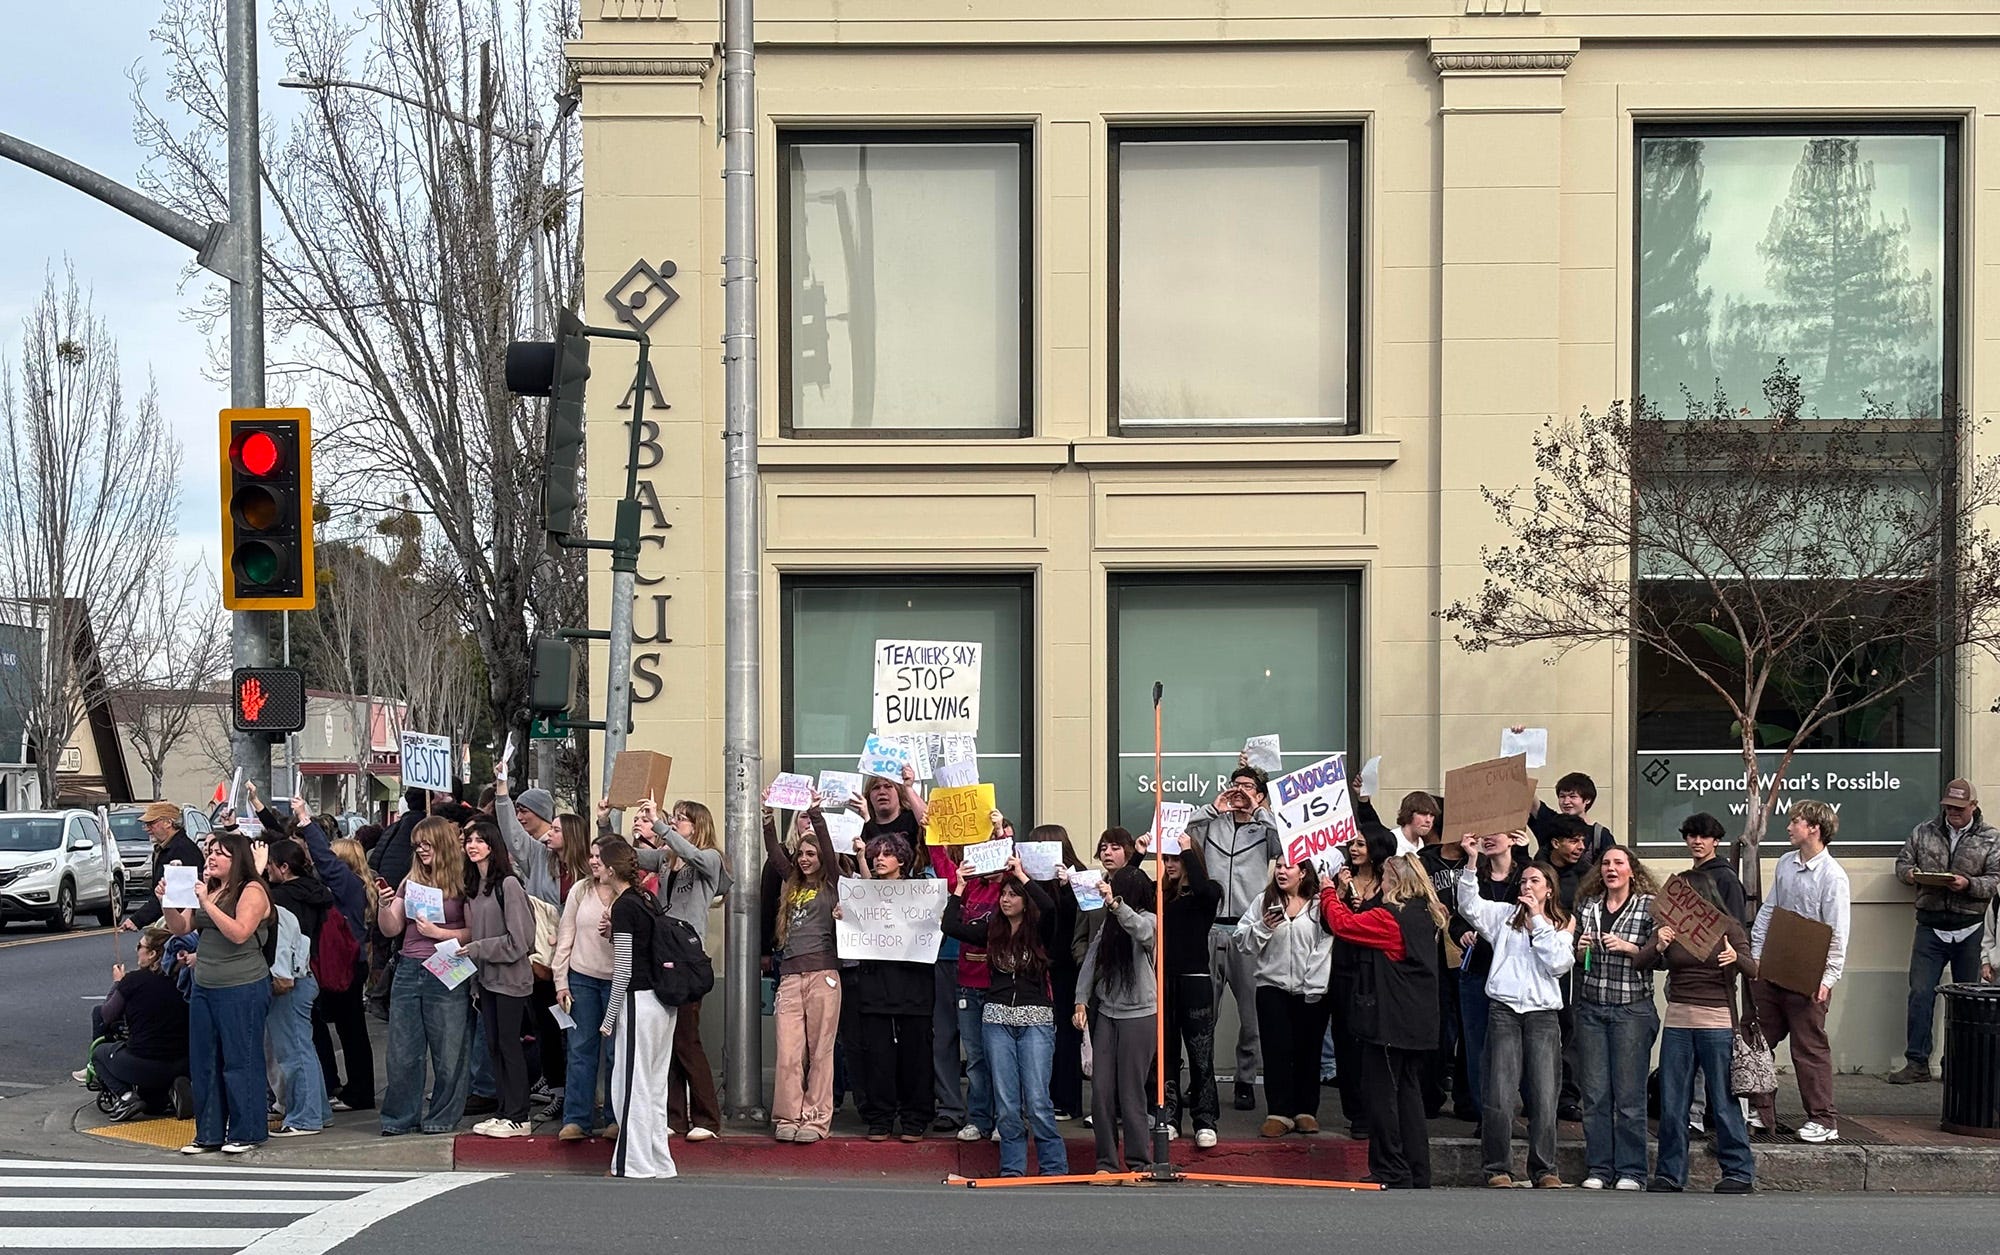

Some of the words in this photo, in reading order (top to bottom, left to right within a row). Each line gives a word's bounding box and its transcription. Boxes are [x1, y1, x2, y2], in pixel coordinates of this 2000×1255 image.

[883, 644, 950, 666] TEACHERS
[952, 645, 977, 667] SAY:
[897, 666, 955, 691] STOP
[886, 695, 970, 724] BULLYING
[404, 743, 450, 788] RESIST
[1137, 773, 1211, 797] Socially
[1276, 756, 1346, 806] ENOUGH
[1676, 771, 1748, 796] Expand
[1756, 772, 1820, 790] What's
[1826, 770, 1901, 790] Possible
[927, 788, 978, 816] MELT
[937, 812, 979, 843] ICE
[1287, 815, 1357, 868] ENOUGH
[840, 882, 866, 901] DO
[874, 884, 906, 898] YOU
[911, 883, 940, 895] KNOW
[1667, 879, 1721, 929] CRUSH
[855, 906, 893, 921] WHERE
[901, 906, 933, 920] YOUR
[1660, 895, 1710, 949] ICE
[840, 932, 904, 948] NEIGHBOR
[914, 932, 934, 948] IS?
